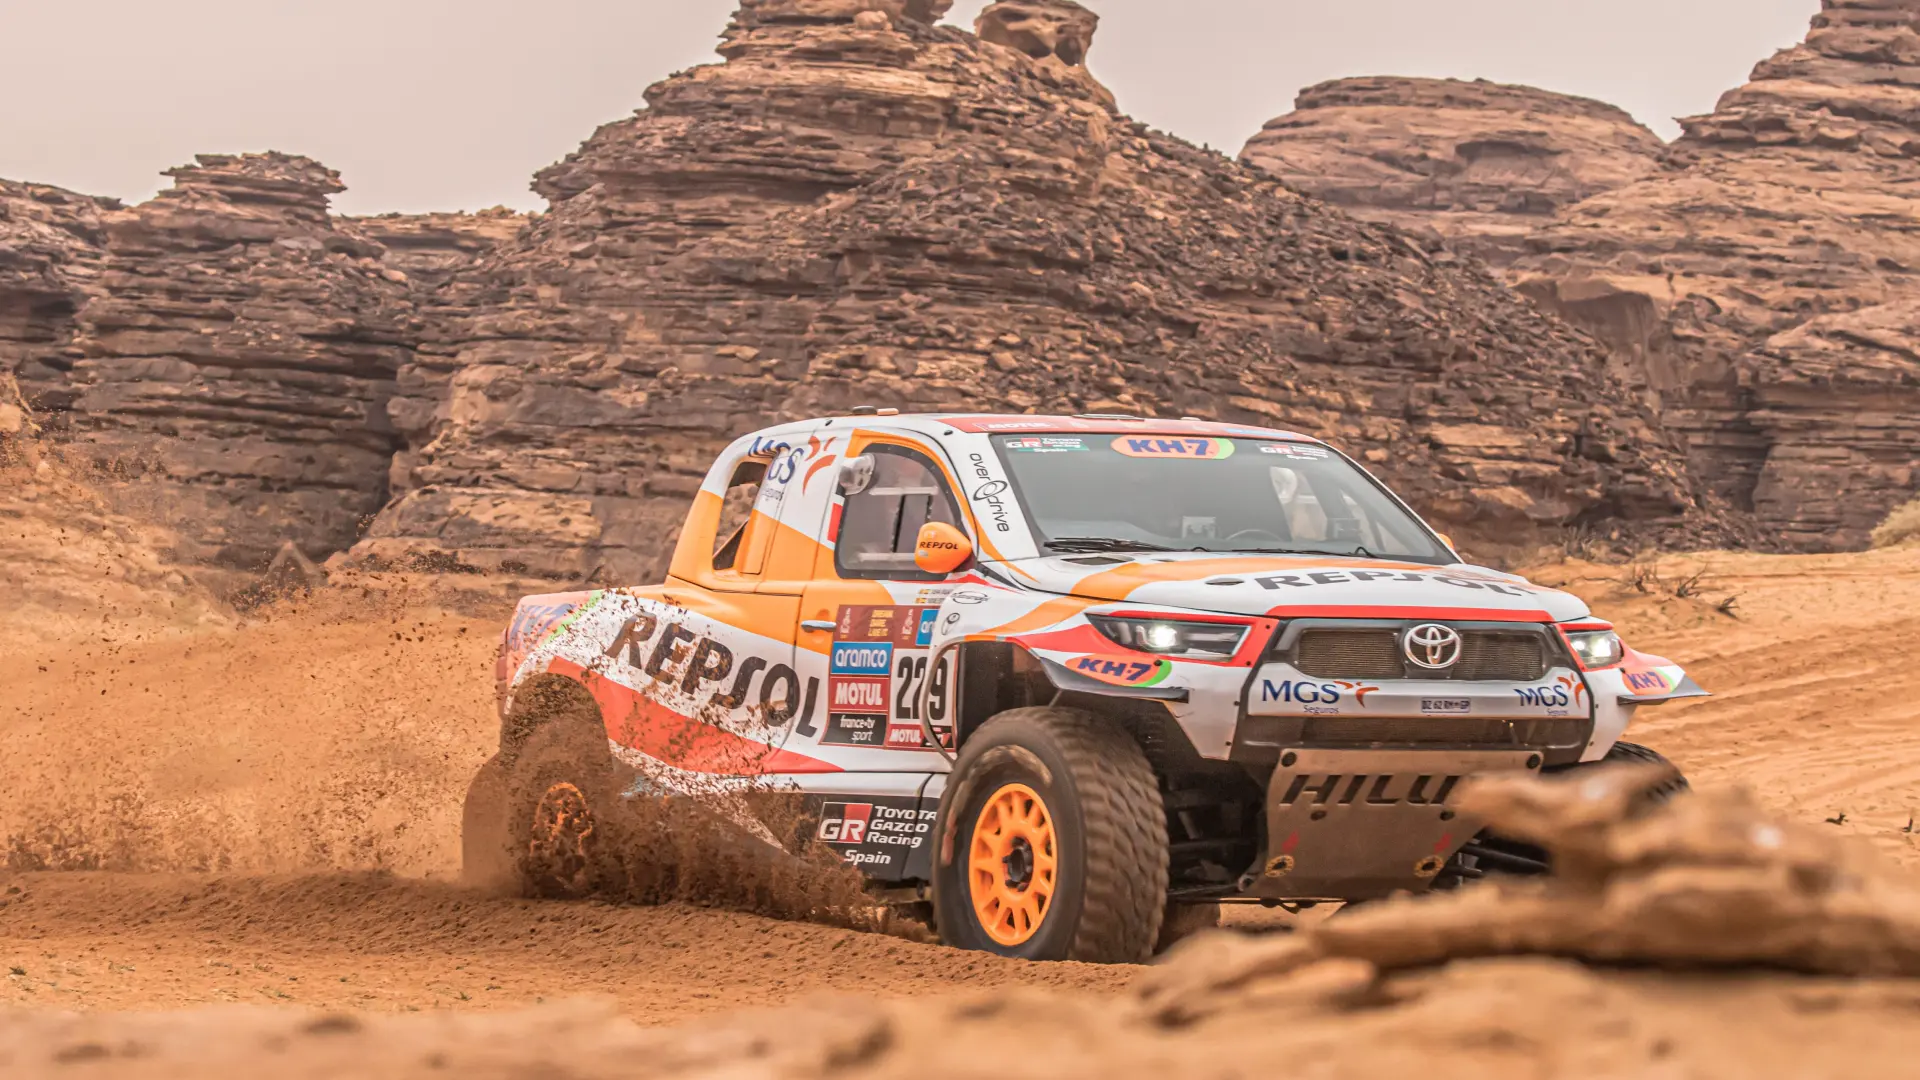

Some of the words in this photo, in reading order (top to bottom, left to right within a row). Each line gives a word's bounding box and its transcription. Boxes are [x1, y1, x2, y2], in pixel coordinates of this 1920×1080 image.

[919, 541, 959, 550] REPSOL
[835, 648, 888, 668] aramco
[604, 611, 820, 738] REPSOL
[835, 682, 884, 706] MOTUL
[1262, 679, 1340, 704] MGS
[1513, 685, 1569, 707] MGS
[851, 730, 874, 744] sport
[888, 728, 922, 743] MOTUL
[1279, 774, 1461, 805] HILU
[874, 805, 938, 821] TOYOTA
[819, 818, 866, 841] GR
[869, 819, 930, 833] GAZOO
[866, 831, 923, 849] Racing
[844, 849, 892, 866] Spain
